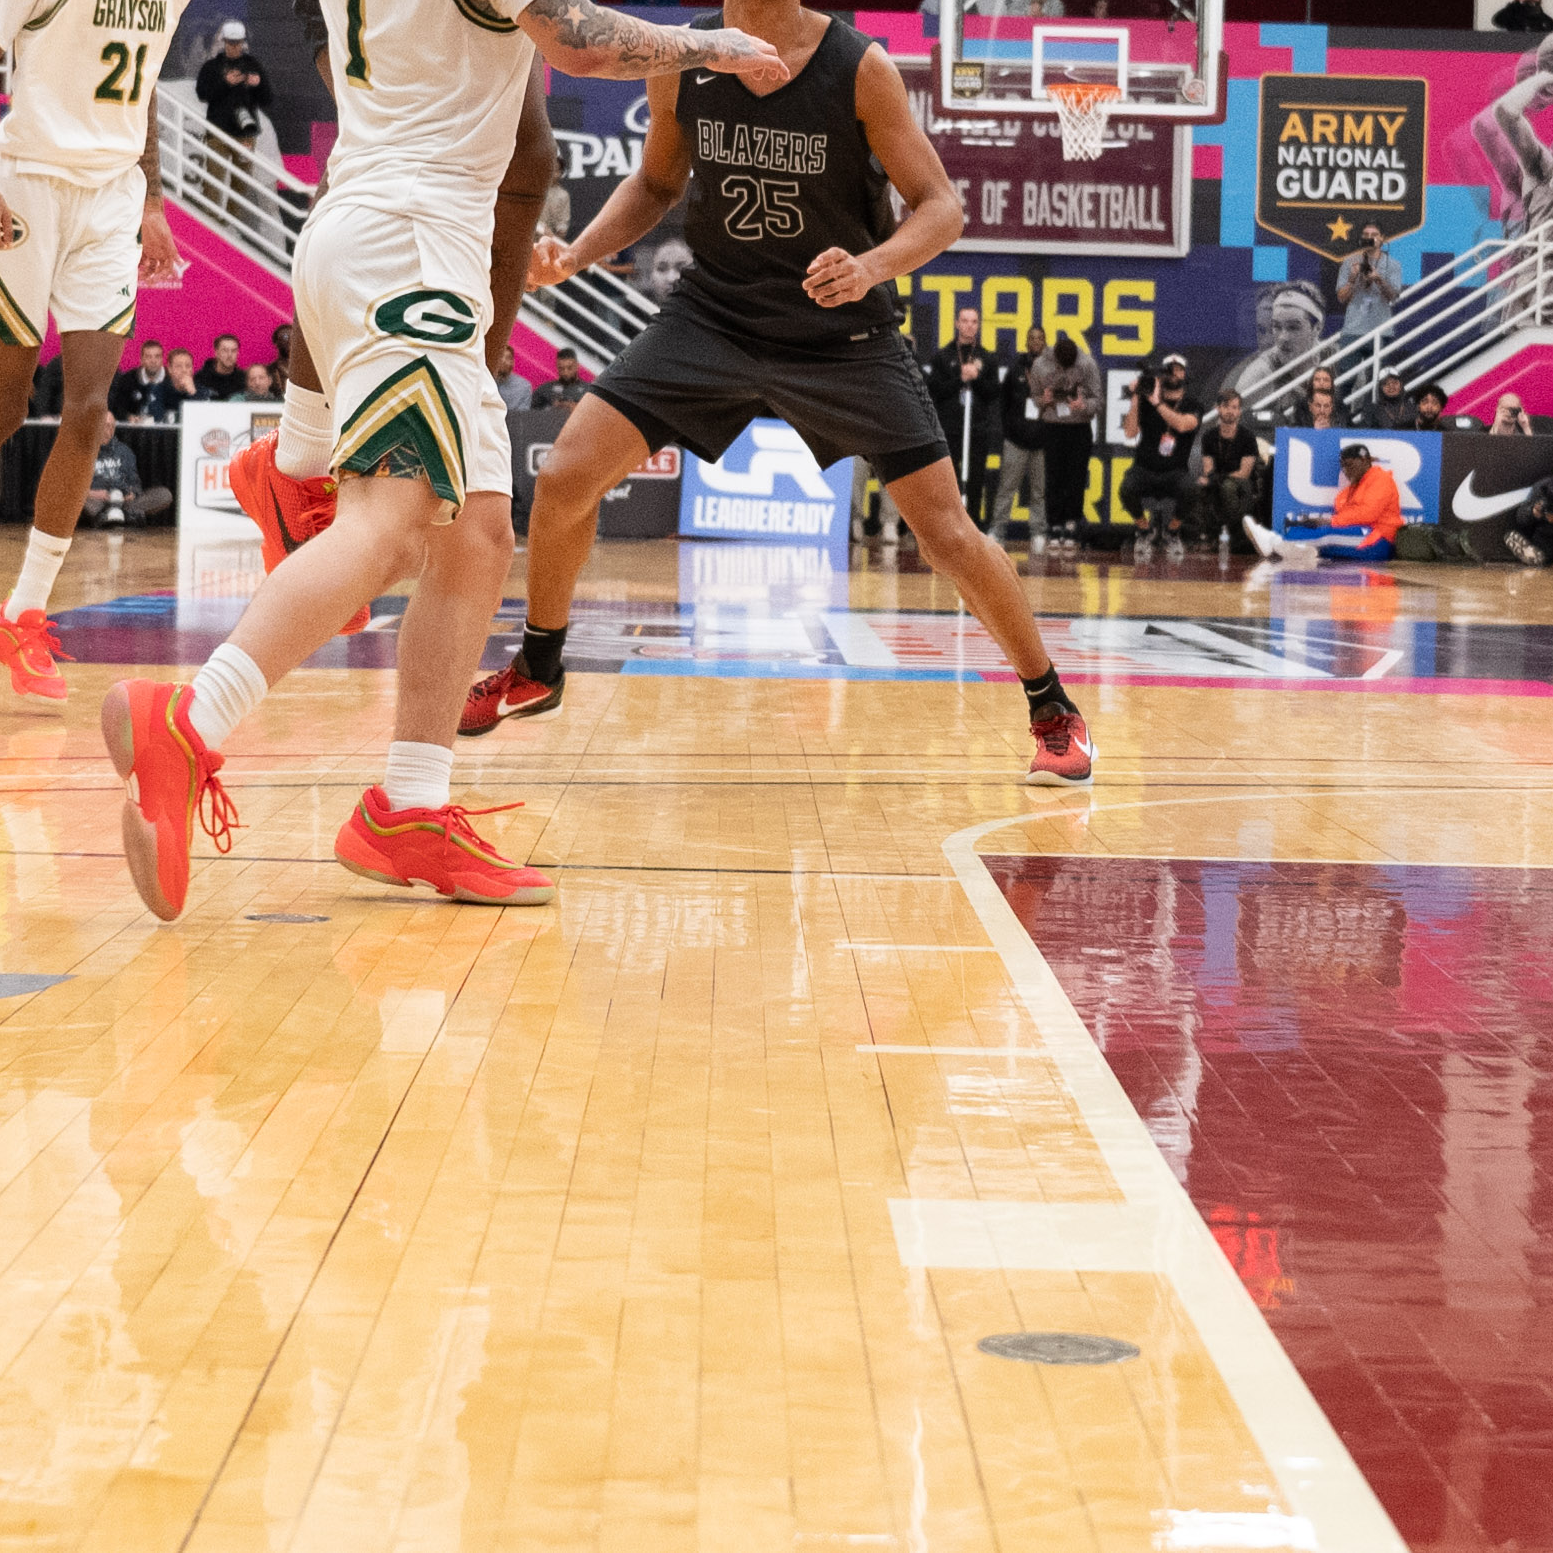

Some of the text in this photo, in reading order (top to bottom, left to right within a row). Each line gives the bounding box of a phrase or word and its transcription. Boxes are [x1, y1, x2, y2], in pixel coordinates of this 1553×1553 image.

[94, 40, 148, 106] 21
[697, 118, 828, 174] BLAZERS
[1279, 111, 1406, 146] ARMY
[1277, 145, 1406, 169] NATIONAL
[721, 175, 805, 241] 25
[981, 180, 1012, 226] OF
[1022, 181, 1166, 232] BASKETBALL
[1276, 168, 1407, 202] GUARD
[693, 495, 836, 536] LEAGUEREADY
